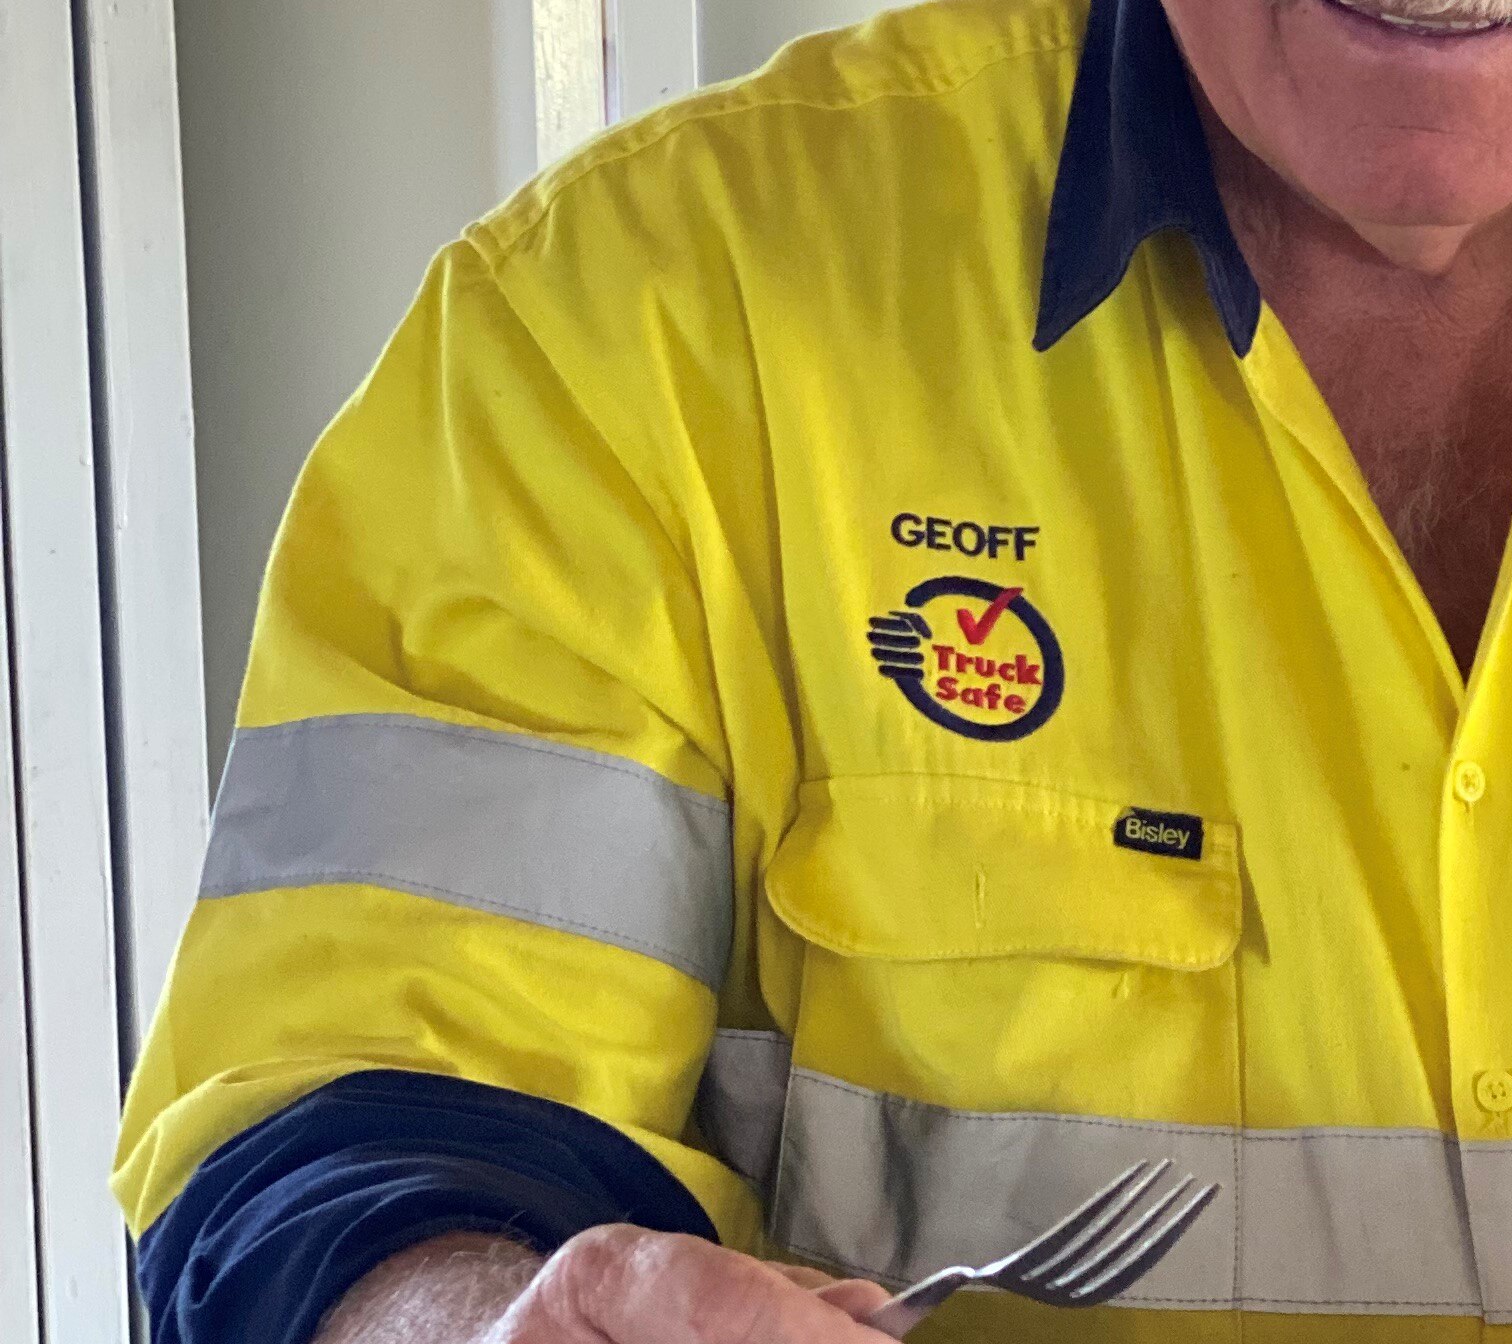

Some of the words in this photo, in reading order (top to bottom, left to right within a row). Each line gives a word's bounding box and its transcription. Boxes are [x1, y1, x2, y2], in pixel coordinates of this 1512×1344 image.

[891, 513, 1039, 560] GEOFF
[932, 644, 1041, 685] Truck
[936, 676, 1026, 714] Safe
[1125, 817, 1190, 849] Bisley
